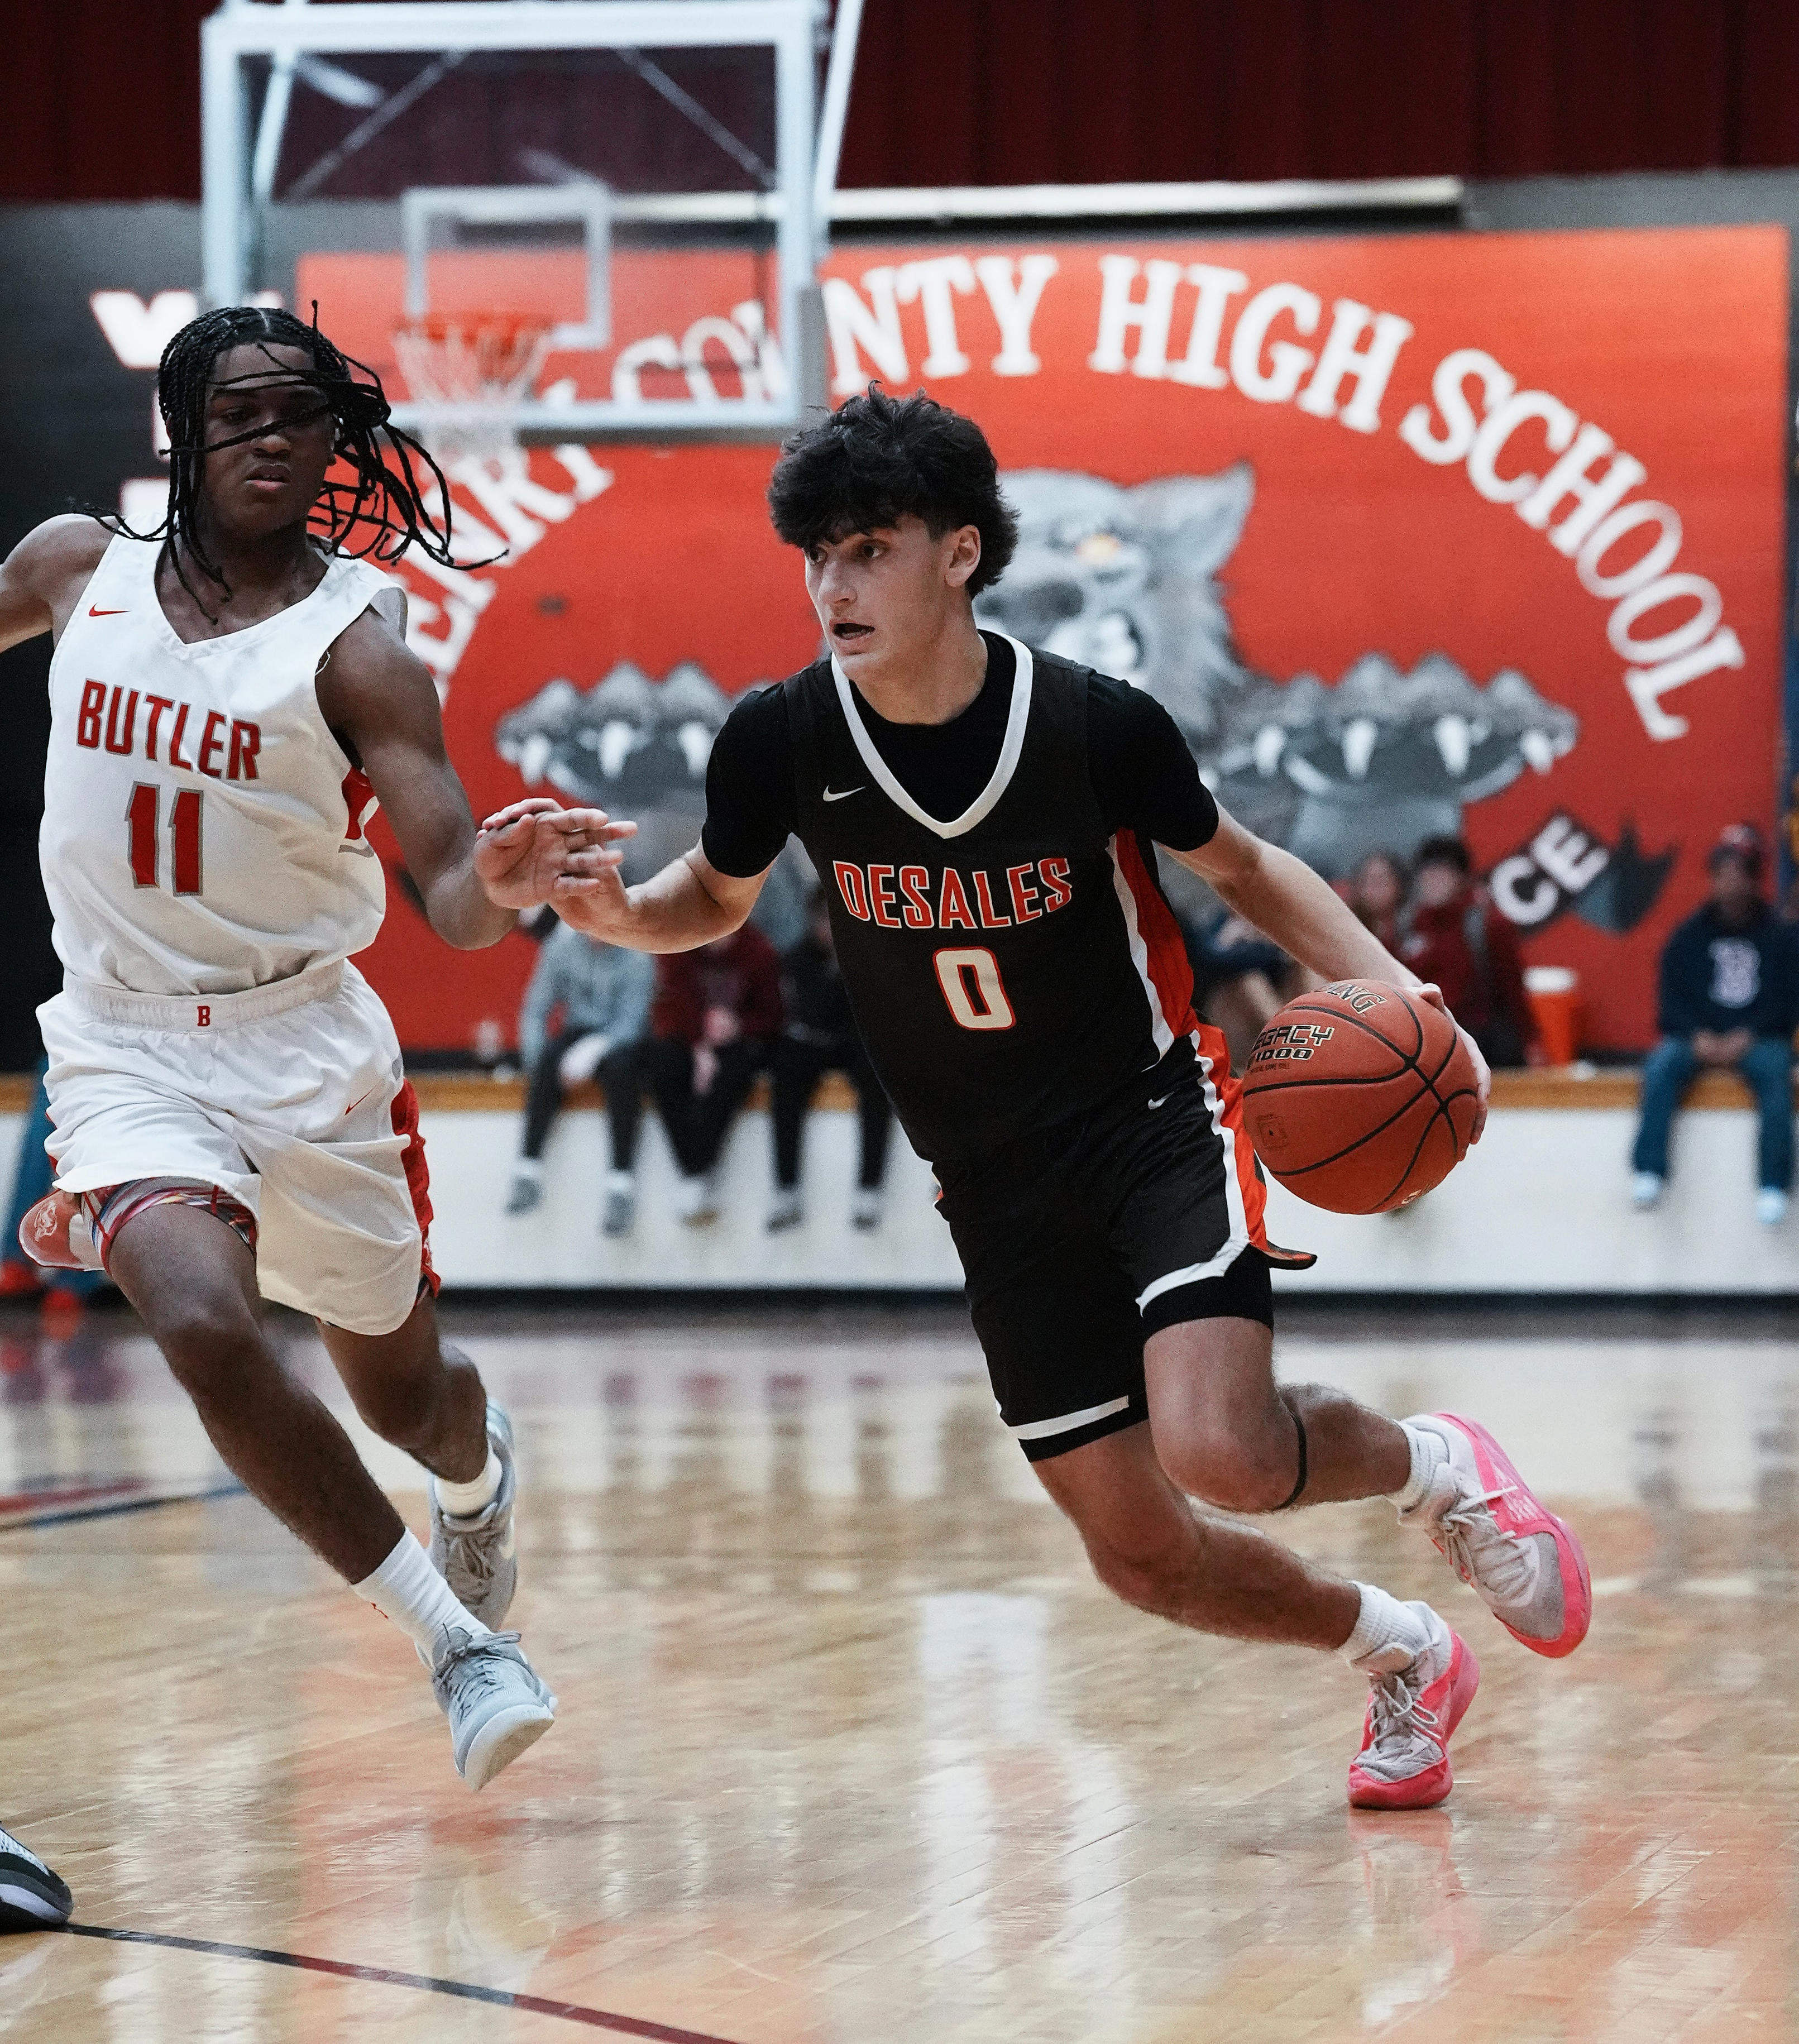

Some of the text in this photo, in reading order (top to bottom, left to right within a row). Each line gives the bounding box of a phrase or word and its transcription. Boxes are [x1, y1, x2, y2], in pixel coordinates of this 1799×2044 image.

[1087, 253, 1414, 434] HIGH
[1399, 347, 1745, 741] SCHOOL
[76, 677, 261, 781] BUTLER
[124, 781, 204, 897] 11
[832, 858, 1072, 929] DESALES
[197, 1005, 210, 1027] B
[932, 946, 1016, 1031] 0
